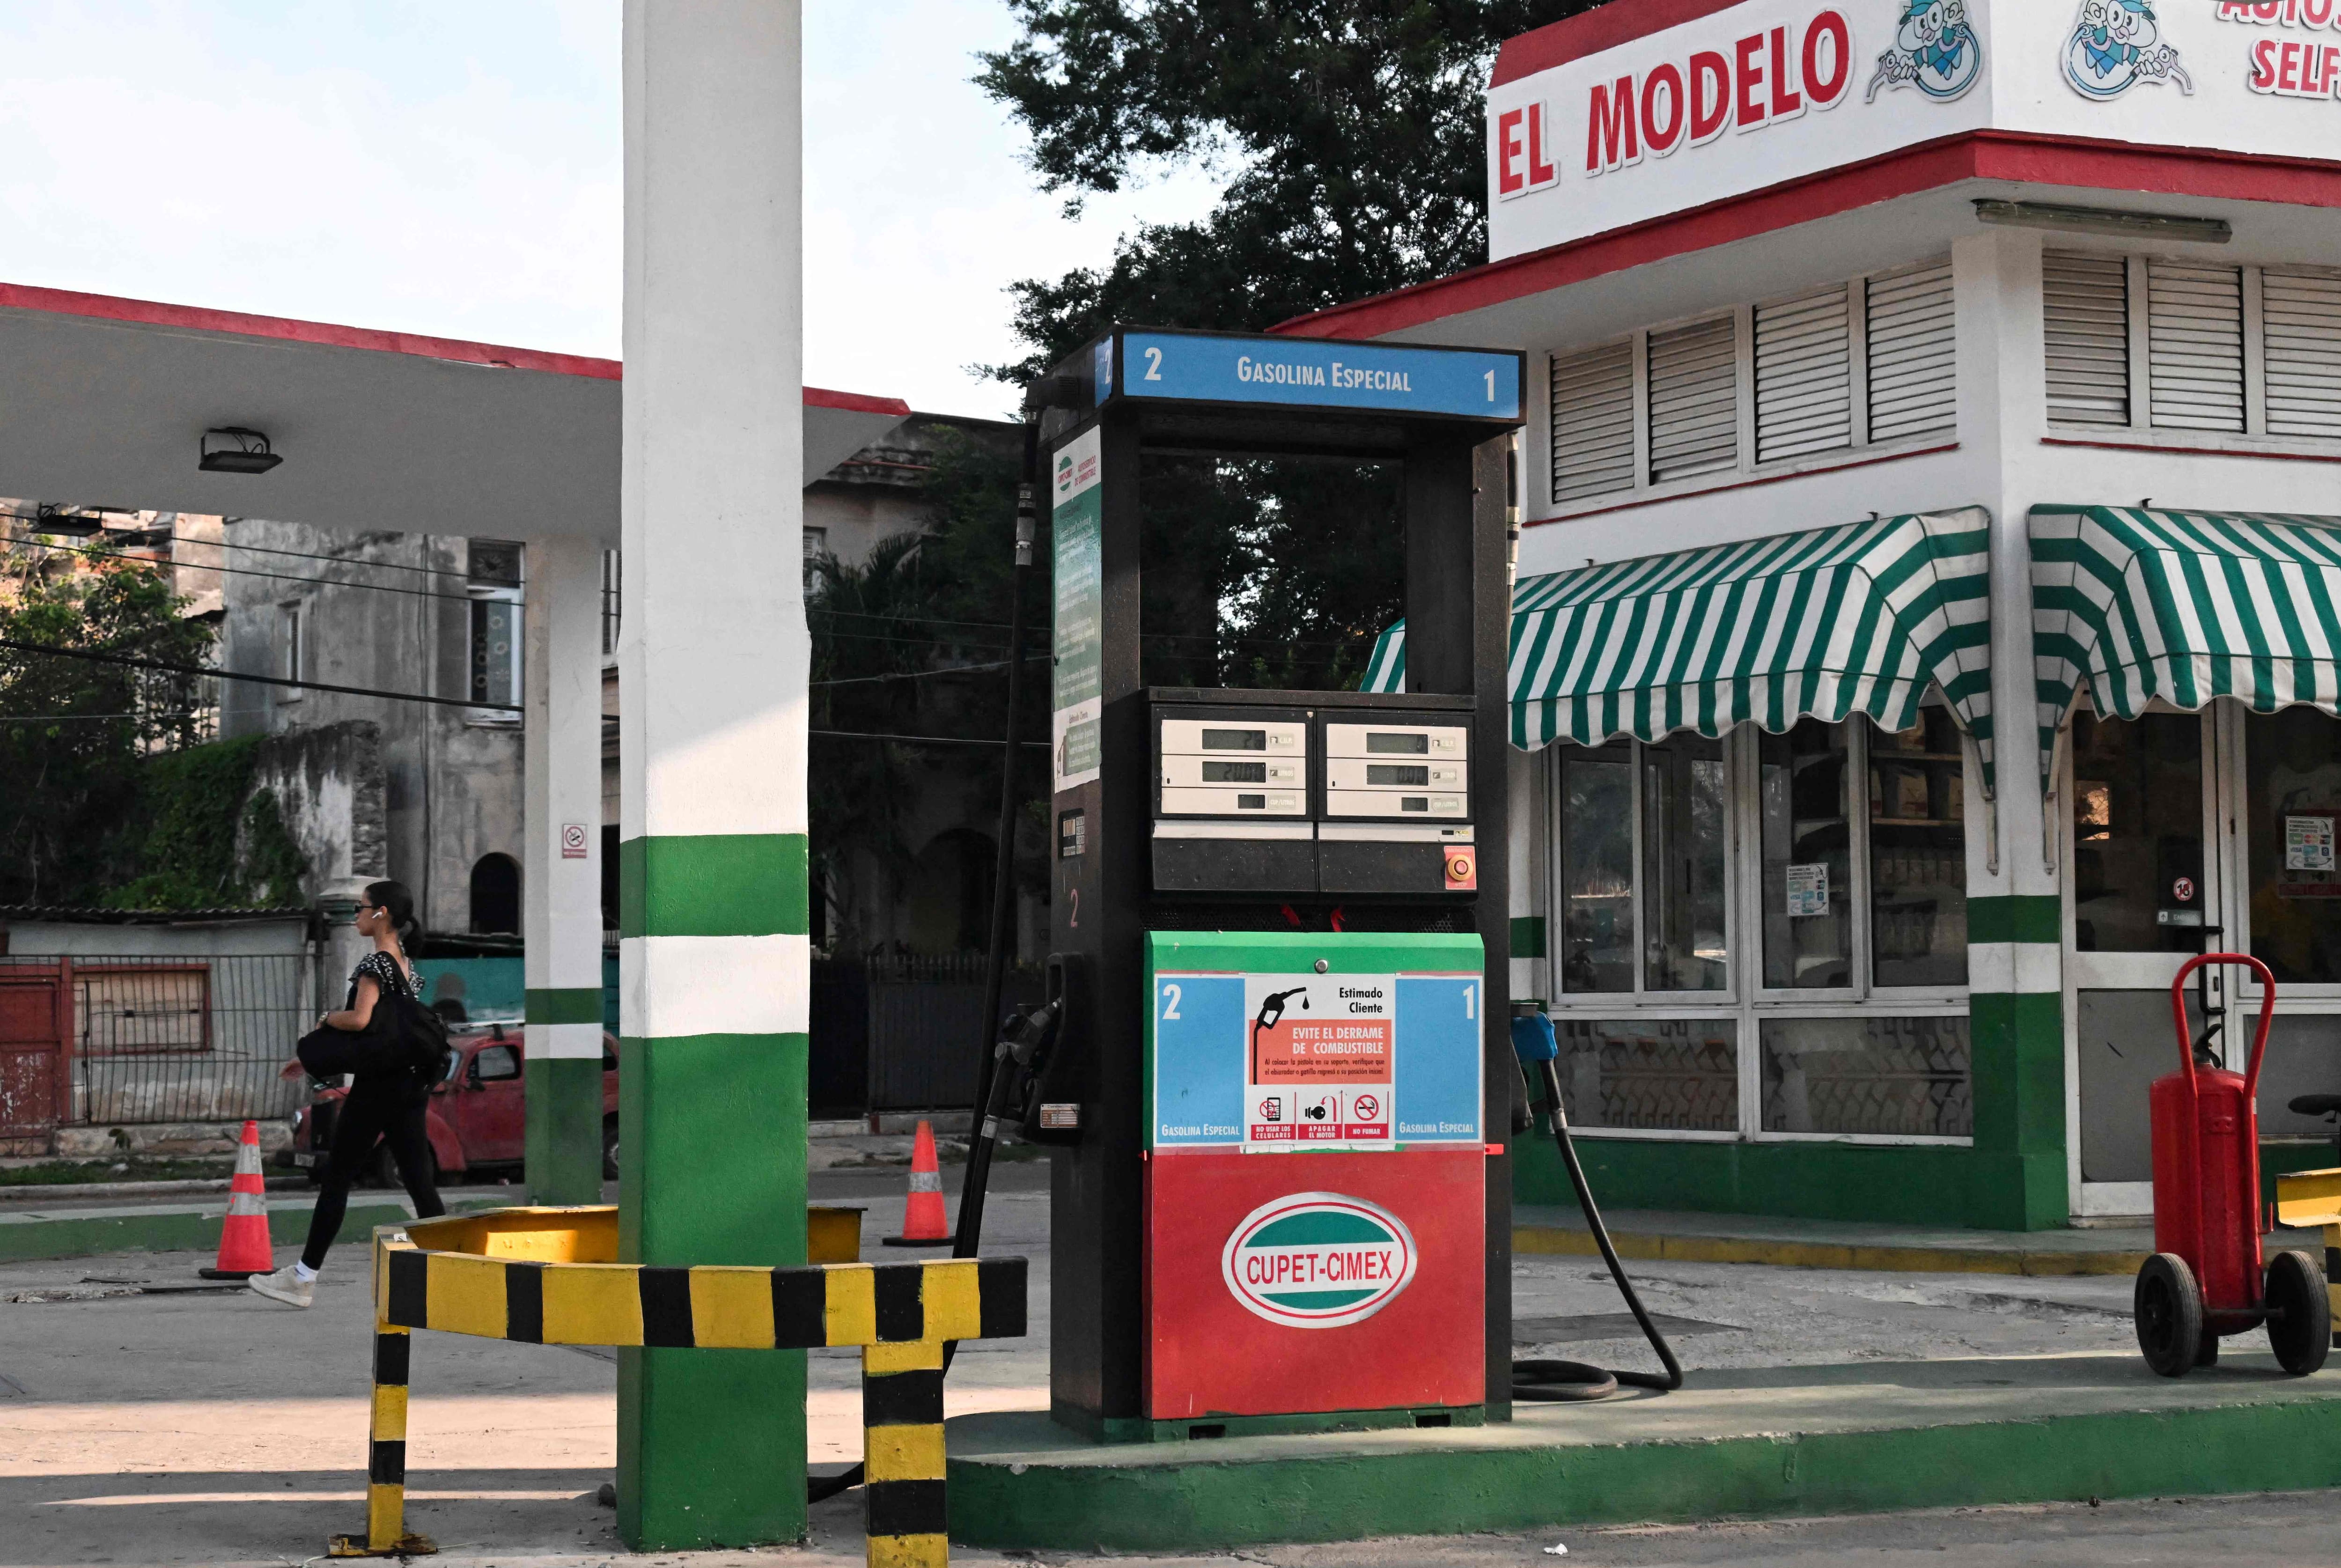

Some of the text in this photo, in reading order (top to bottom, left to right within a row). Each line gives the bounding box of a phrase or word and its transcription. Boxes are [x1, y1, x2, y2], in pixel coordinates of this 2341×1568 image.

[2252, 40, 2341, 93] SELF
[1500, 11, 1850, 194] EL MODELO
[1145, 347, 1495, 402] 2 GASOLINA ESPECIAL 1
[1070, 889, 1078, 928] 2
[1340, 987, 1383, 998] Estimado
[1162, 984, 1182, 1020] 2
[1349, 1002, 1383, 1013] Cliente
[1462, 985, 1474, 1019] 1
[1293, 1027, 1383, 1039] EVITE EL DERRAME
[1293, 1043, 1383, 1054] DE COMBUSTIBLE
[1297, 1058, 1314, 1067] pistola
[1352, 1058, 1374, 1067] verifique
[1301, 1068, 1316, 1076] gatillo
[1348, 1068, 1368, 1076] posición
[1162, 1124, 1240, 1136] GASOLINA ESPECIAL
[1399, 1121, 1474, 1134] GASOLINA ESPECIAL
[1247, 1251, 1392, 1285] CUPET-CIMEX
